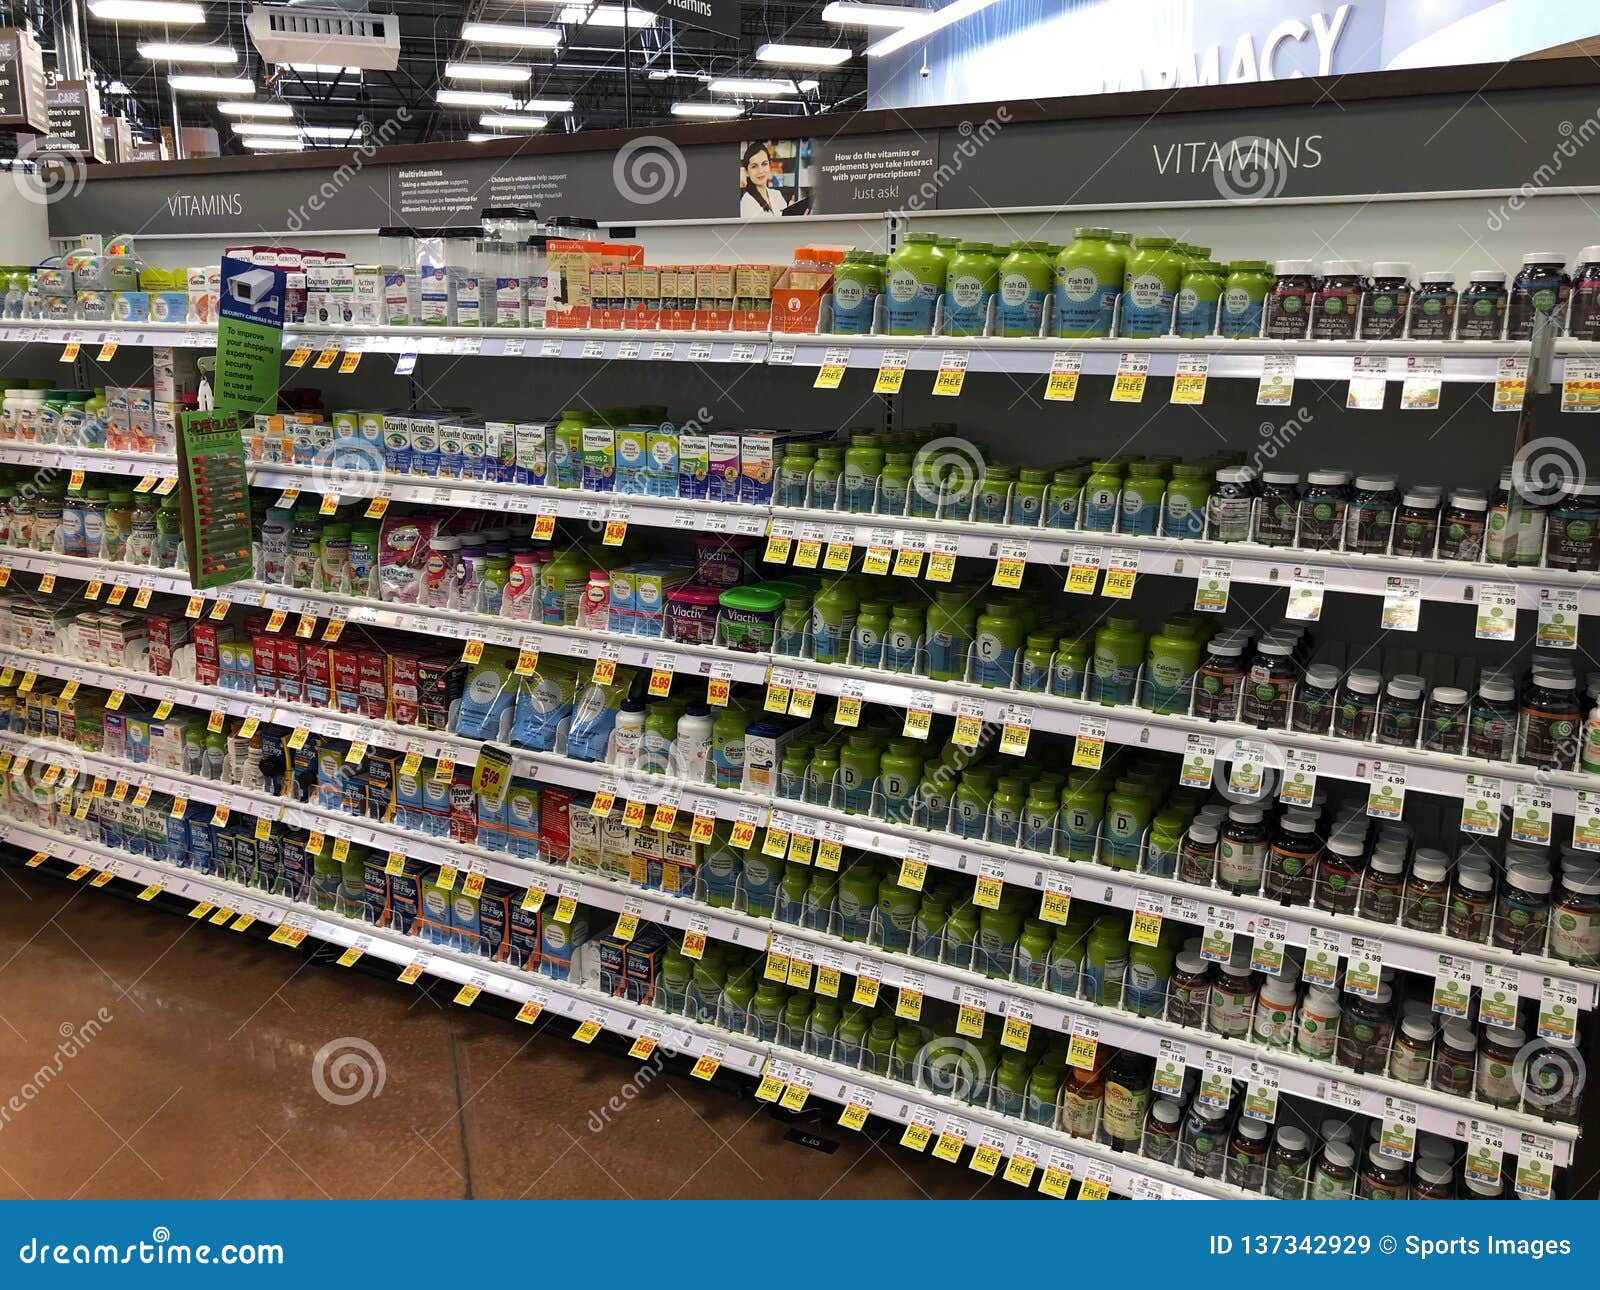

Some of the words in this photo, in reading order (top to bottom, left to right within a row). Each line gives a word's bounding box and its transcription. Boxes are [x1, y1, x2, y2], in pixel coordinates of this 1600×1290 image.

[668, 0, 712, 16] tamins
[835, 153, 852, 161] How
[853, 152, 862, 160] do
[878, 149, 910, 158] vitamins
[1153, 136, 1323, 175] VITAMINS
[822, 162, 869, 172] supplements
[870, 162, 884, 170] you
[886, 160, 902, 168] take
[903, 158, 933, 167] interact
[399, 169, 443, 179] Multivitamins
[833, 173, 849, 181] with
[850, 173, 867, 182] your
[869, 169, 921, 180] prescriptions?
[852, 187, 875, 200] Just
[878, 185, 899, 199] ask!
[168, 193, 242, 217] VITAMINS
[358, 286, 374, 294] Mind
[955, 282, 970, 292] Fish
[970, 282, 980, 291] Oil
[1003, 281, 1017, 290] Fish
[1017, 281, 1028, 290] Oil
[222, 310, 245, 320] SECURITY
[245, 314, 266, 324] CAMERAS
[227, 327, 236, 335] To
[237, 329, 265, 341] improve
[226, 339, 243, 348] your
[244, 341, 274, 354] shopping
[226, 349, 265, 363] experience,
[225, 360, 253, 372] security
[1132, 364, 1148, 372] 9.99
[225, 371, 254, 381] cameras
[879, 376, 901, 384] FREE
[232, 382, 244, 390] use
[245, 383, 253, 391] at
[1051, 381, 1075, 390] FREE
[223, 391, 236, 399] this
[384, 421, 408, 432] Ocuvite
[411, 423, 435, 434] Ocuvite
[440, 429, 461, 439] Ocuvite
[463, 431, 484, 442] Ocuvite
[1100, 495, 1108, 504] B
[769, 545, 788, 554] FREE
[698, 549, 729, 562] Viactiv
[899, 559, 920, 567] FREE
[1085, 557, 1100, 565] 6.99
[1070, 575, 1094, 584] FREE
[672, 605, 704, 619] Viactiv
[1558, 603, 1578, 612] 5.99
[728, 609, 761, 624] Viactiv
[862, 633, 871, 644] C
[897, 637, 906, 648] C
[596, 664, 615, 678] 3.74
[1156, 663, 1181, 674] Calcium
[476, 680, 497, 689] Calcium
[650, 676, 670, 689] 6.99
[769, 693, 788, 703] FREE
[839, 706, 859, 716] FREE
[971, 709, 984, 717] 7.99
[1018, 717, 1032, 726] 5.49
[1091, 729, 1106, 738] 9.99
[1004, 735, 1027, 745] FREE
[1300, 764, 1317, 773] 5.29
[1388, 776, 1405, 785] 4.99
[451, 788, 472, 796] Move
[594, 797, 613, 812] 11.49
[1533, 800, 1552, 809] 8.99
[625, 807, 644, 821] 5.24
[576, 821, 594, 829] Free
[694, 823, 713, 837] 7.19
[638, 833, 659, 844] TRIPLE
[733, 829, 753, 843] 11.49
[635, 839, 653, 850] FLEX
[671, 840, 692, 851] TRIPLE
[768, 836, 787, 847] FREE
[667, 846, 686, 857] FLEX
[904, 868, 925, 880] FREE
[1058, 885, 1072, 893] 5.99
[1045, 901, 1068, 913] FREE
[1149, 905, 1164, 913] 5.99
[1219, 922, 1235, 930] 8.99
[1269, 932, 1286, 941] 6.99
[685, 935, 705, 950] 25.49
[1323, 942, 1339, 952] 7.99
[1364, 953, 1382, 963] 5.99
[820, 976, 838, 986] FREE
[1454, 971, 1471, 982] 7.49
[1500, 981, 1518, 992] 7.99
[1559, 994, 1577, 1005] 7.99
[1007, 1027, 1029, 1039] FREE
[1217, 1065, 1233, 1074] 9.99
[762, 1082, 781, 1094] FREE
[1344, 1097, 1361, 1107] 11.99
[1399, 1115, 1417, 1125] 4.99
[907, 1130, 929, 1142] FREE
[1485, 1138, 1503, 1148] 9.49
[1536, 1151, 1554, 1161] 14.99
